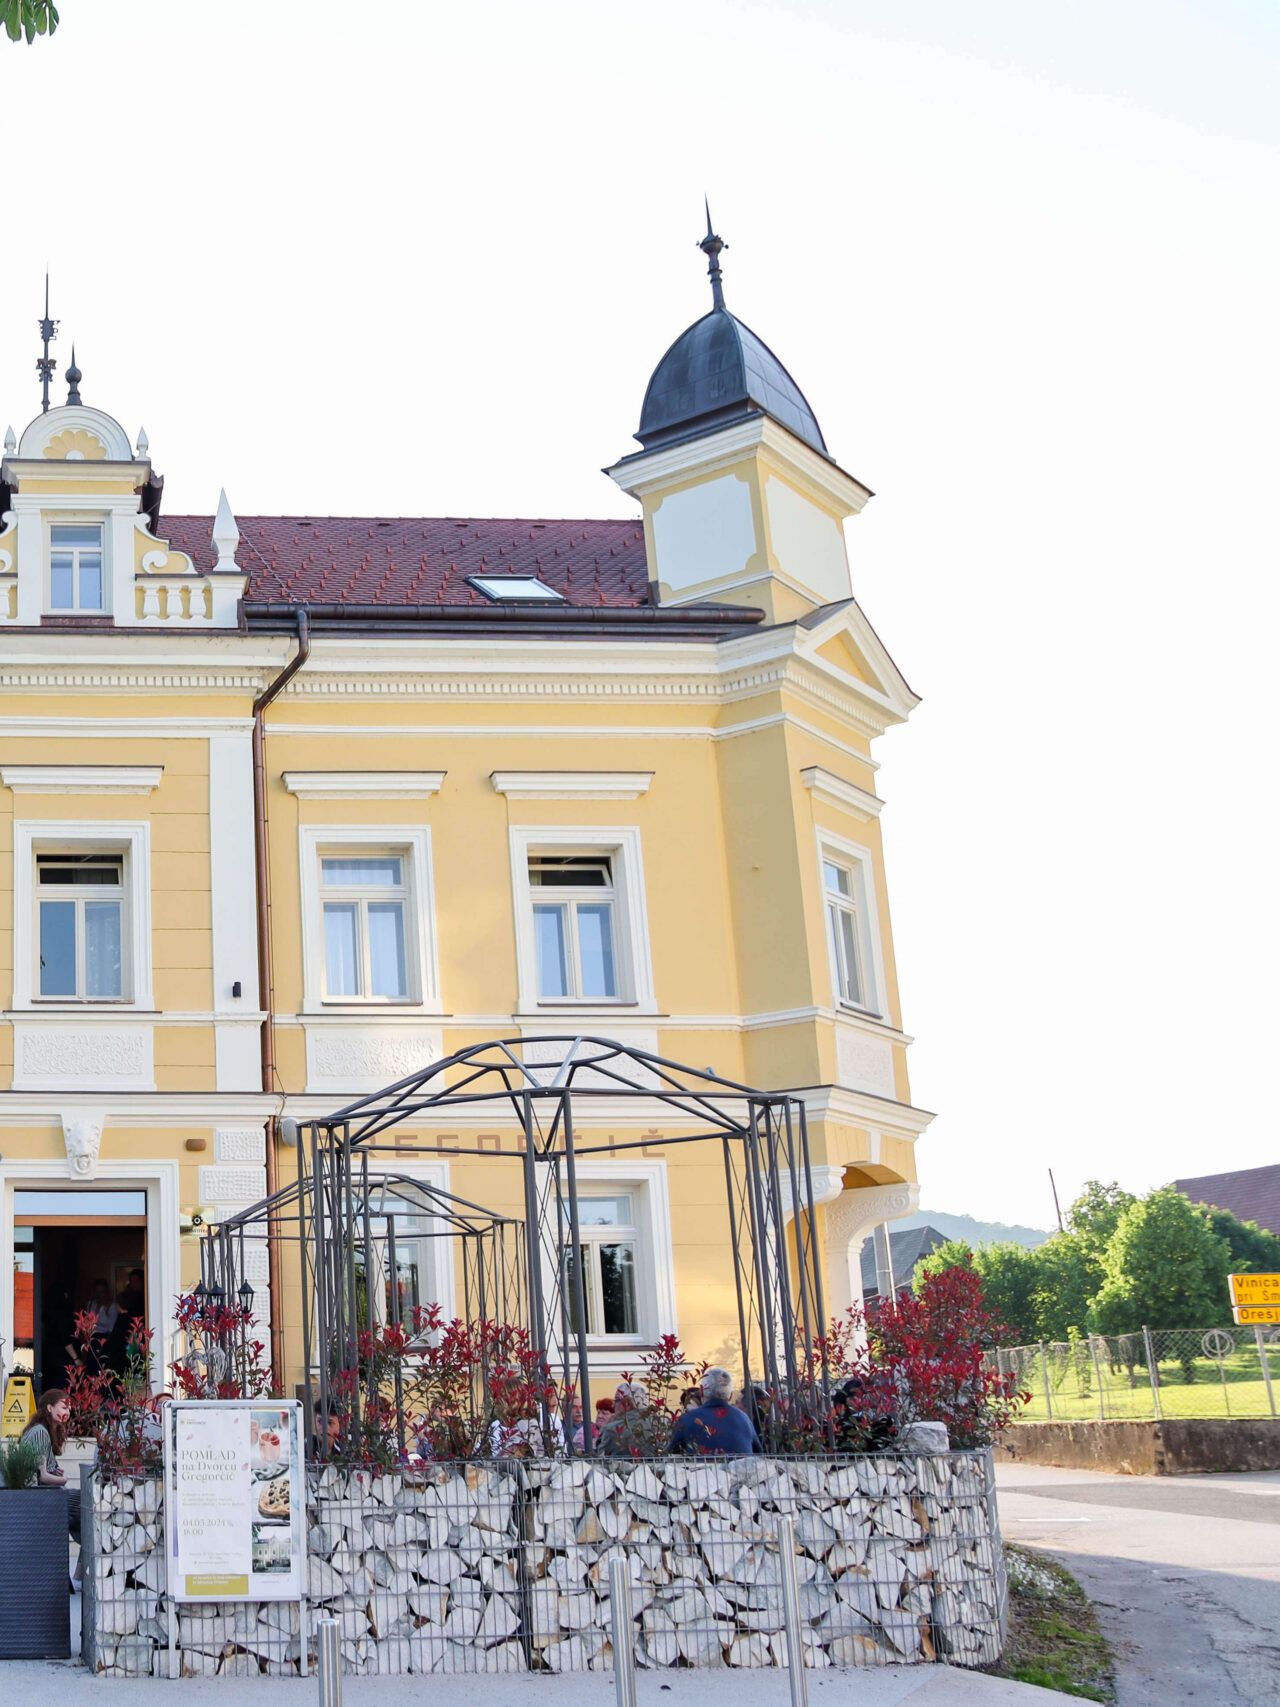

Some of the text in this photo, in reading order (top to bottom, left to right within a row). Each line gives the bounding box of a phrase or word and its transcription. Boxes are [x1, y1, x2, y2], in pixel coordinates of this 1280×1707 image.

[314, 1127, 666, 1158] REGORČIČ
[1234, 1277, 1280, 1288] Vinica
[1262, 1288, 1280, 1301] Šm
[1240, 1308, 1280, 1322] Orešj
